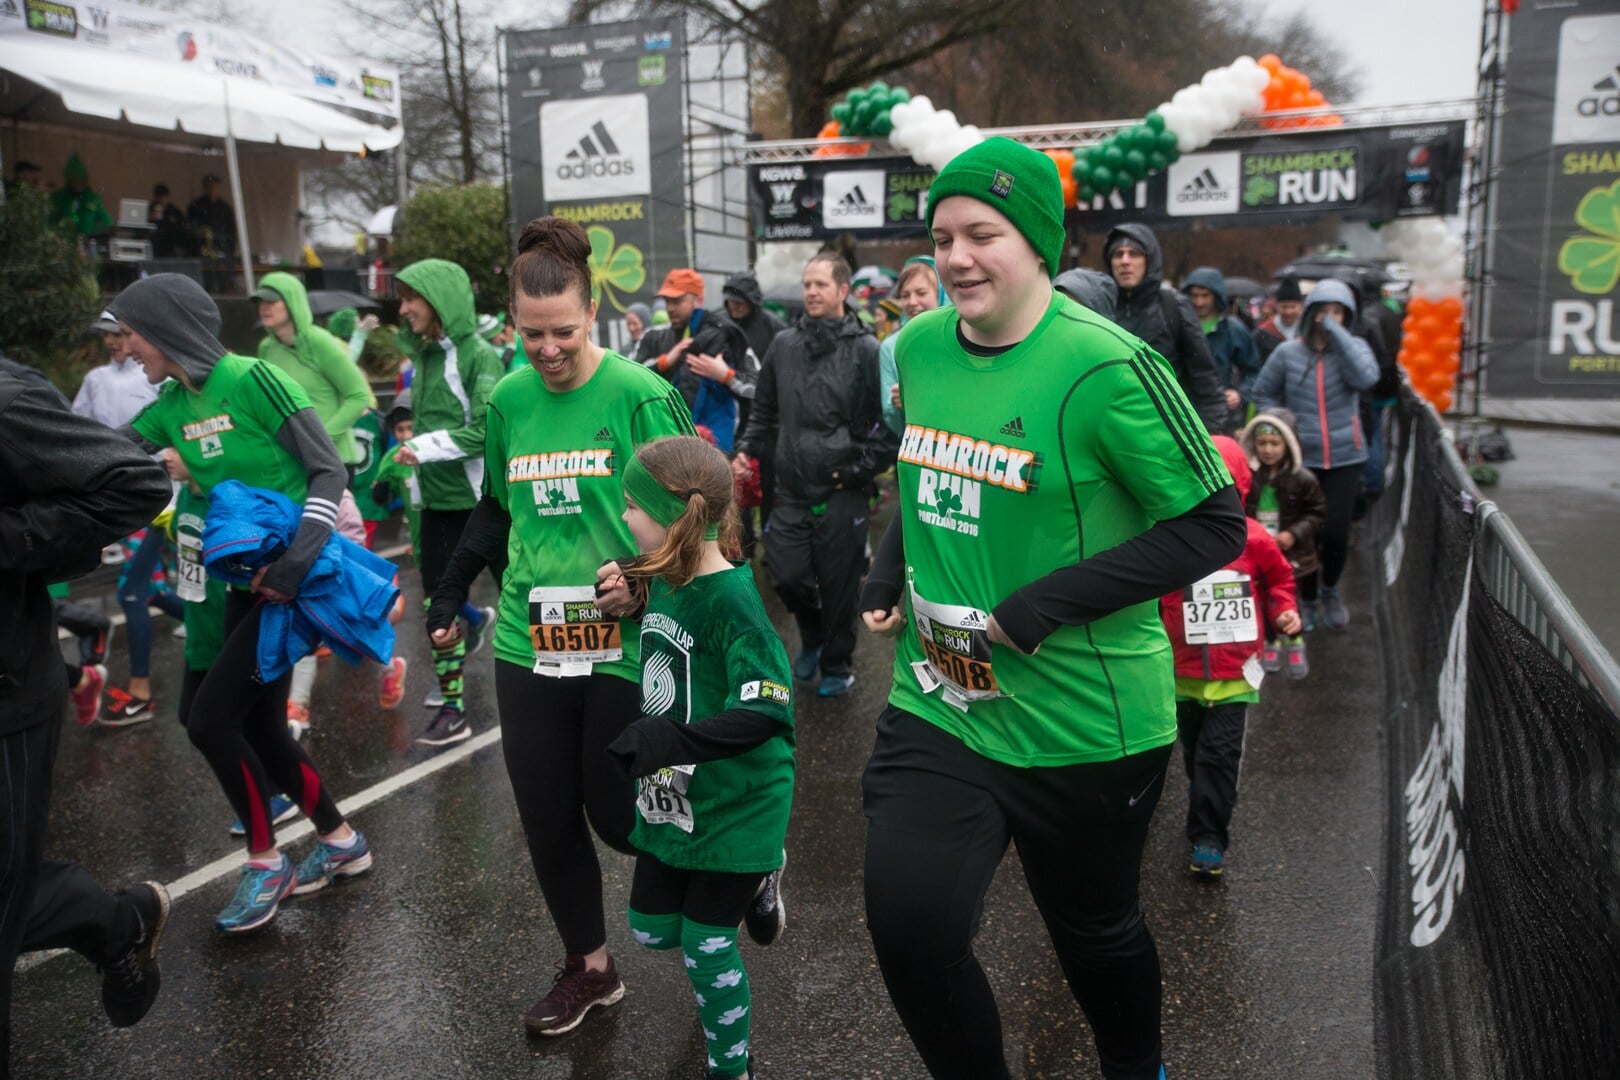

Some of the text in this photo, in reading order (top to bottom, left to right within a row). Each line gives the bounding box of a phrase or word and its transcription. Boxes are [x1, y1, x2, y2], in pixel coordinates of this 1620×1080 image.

[557, 160, 635, 179] adidas
[1244, 149, 1357, 175] SHAMROCK
[1279, 169, 1357, 205] RUN
[552, 201, 644, 223] SHAMROCK
[765, 224, 813, 239] LifeWise
[999, 427, 1026, 440] adidas
[508, 448, 613, 482] SHAMROCK
[898, 424, 1034, 493] SHAMROCK
[532, 477, 581, 505] RUN
[917, 467, 982, 519] RUN
[917, 509, 979, 537] PORTLAND 2016
[579, 608, 603, 619] RUN
[1187, 599, 1252, 624] 37236
[641, 612, 695, 651] LEPRECHAUN LAP
[960, 620, 986, 629] adidas
[535, 623, 615, 652] 16507
[944, 633, 971, 653] RUN
[772, 687, 790, 704] RUN
